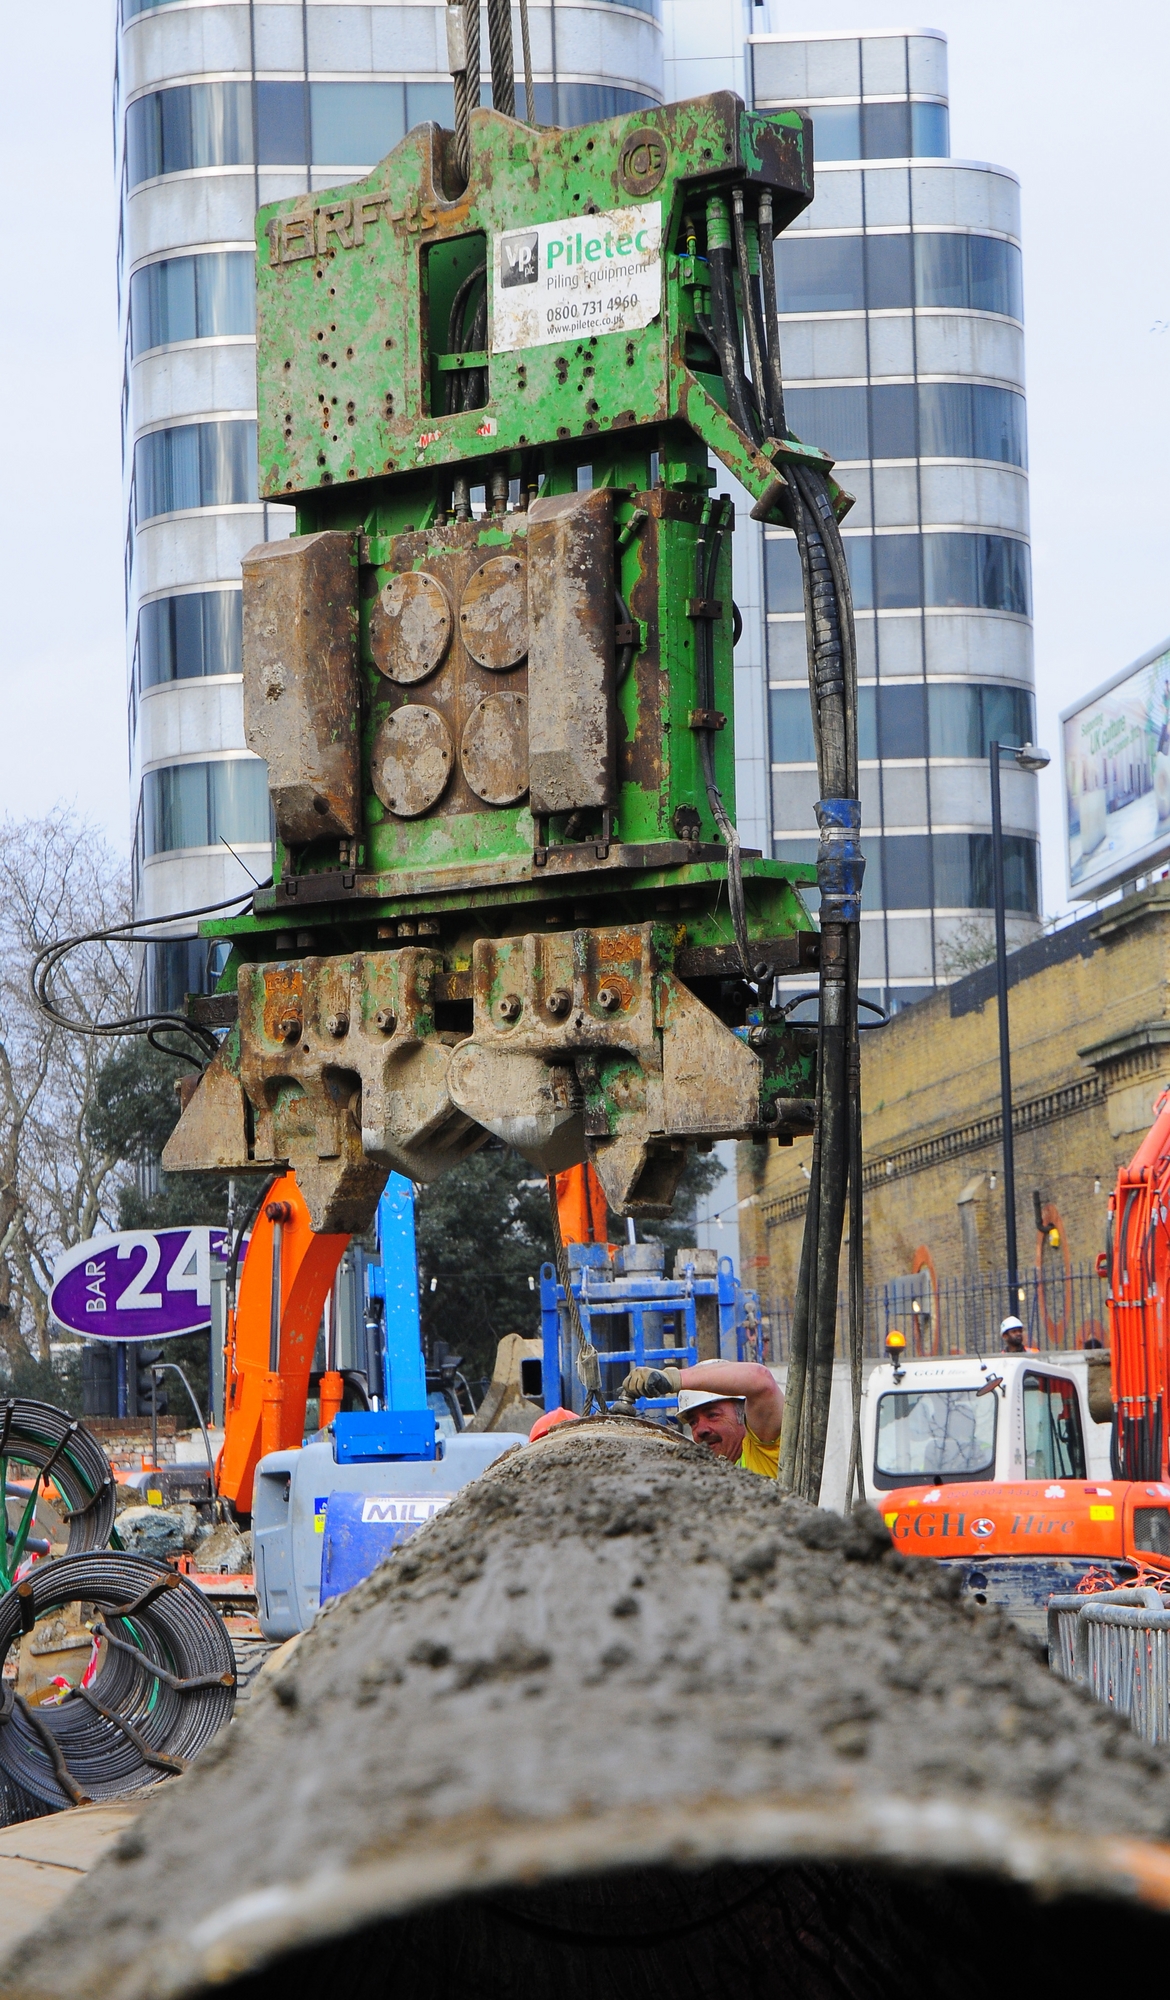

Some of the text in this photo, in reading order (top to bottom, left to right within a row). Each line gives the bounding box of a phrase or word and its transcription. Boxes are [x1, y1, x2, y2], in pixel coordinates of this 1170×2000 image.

[547, 229, 648, 270] Piletec
[547, 263, 648, 290] Piling Equipment
[547, 293, 638, 322] 0800 731 4960
[547, 313, 624, 335] www.piletec.co.uk
[86, 1227, 211, 1313] BAR 24
[892, 1512, 1075, 1539] GGH Hire
